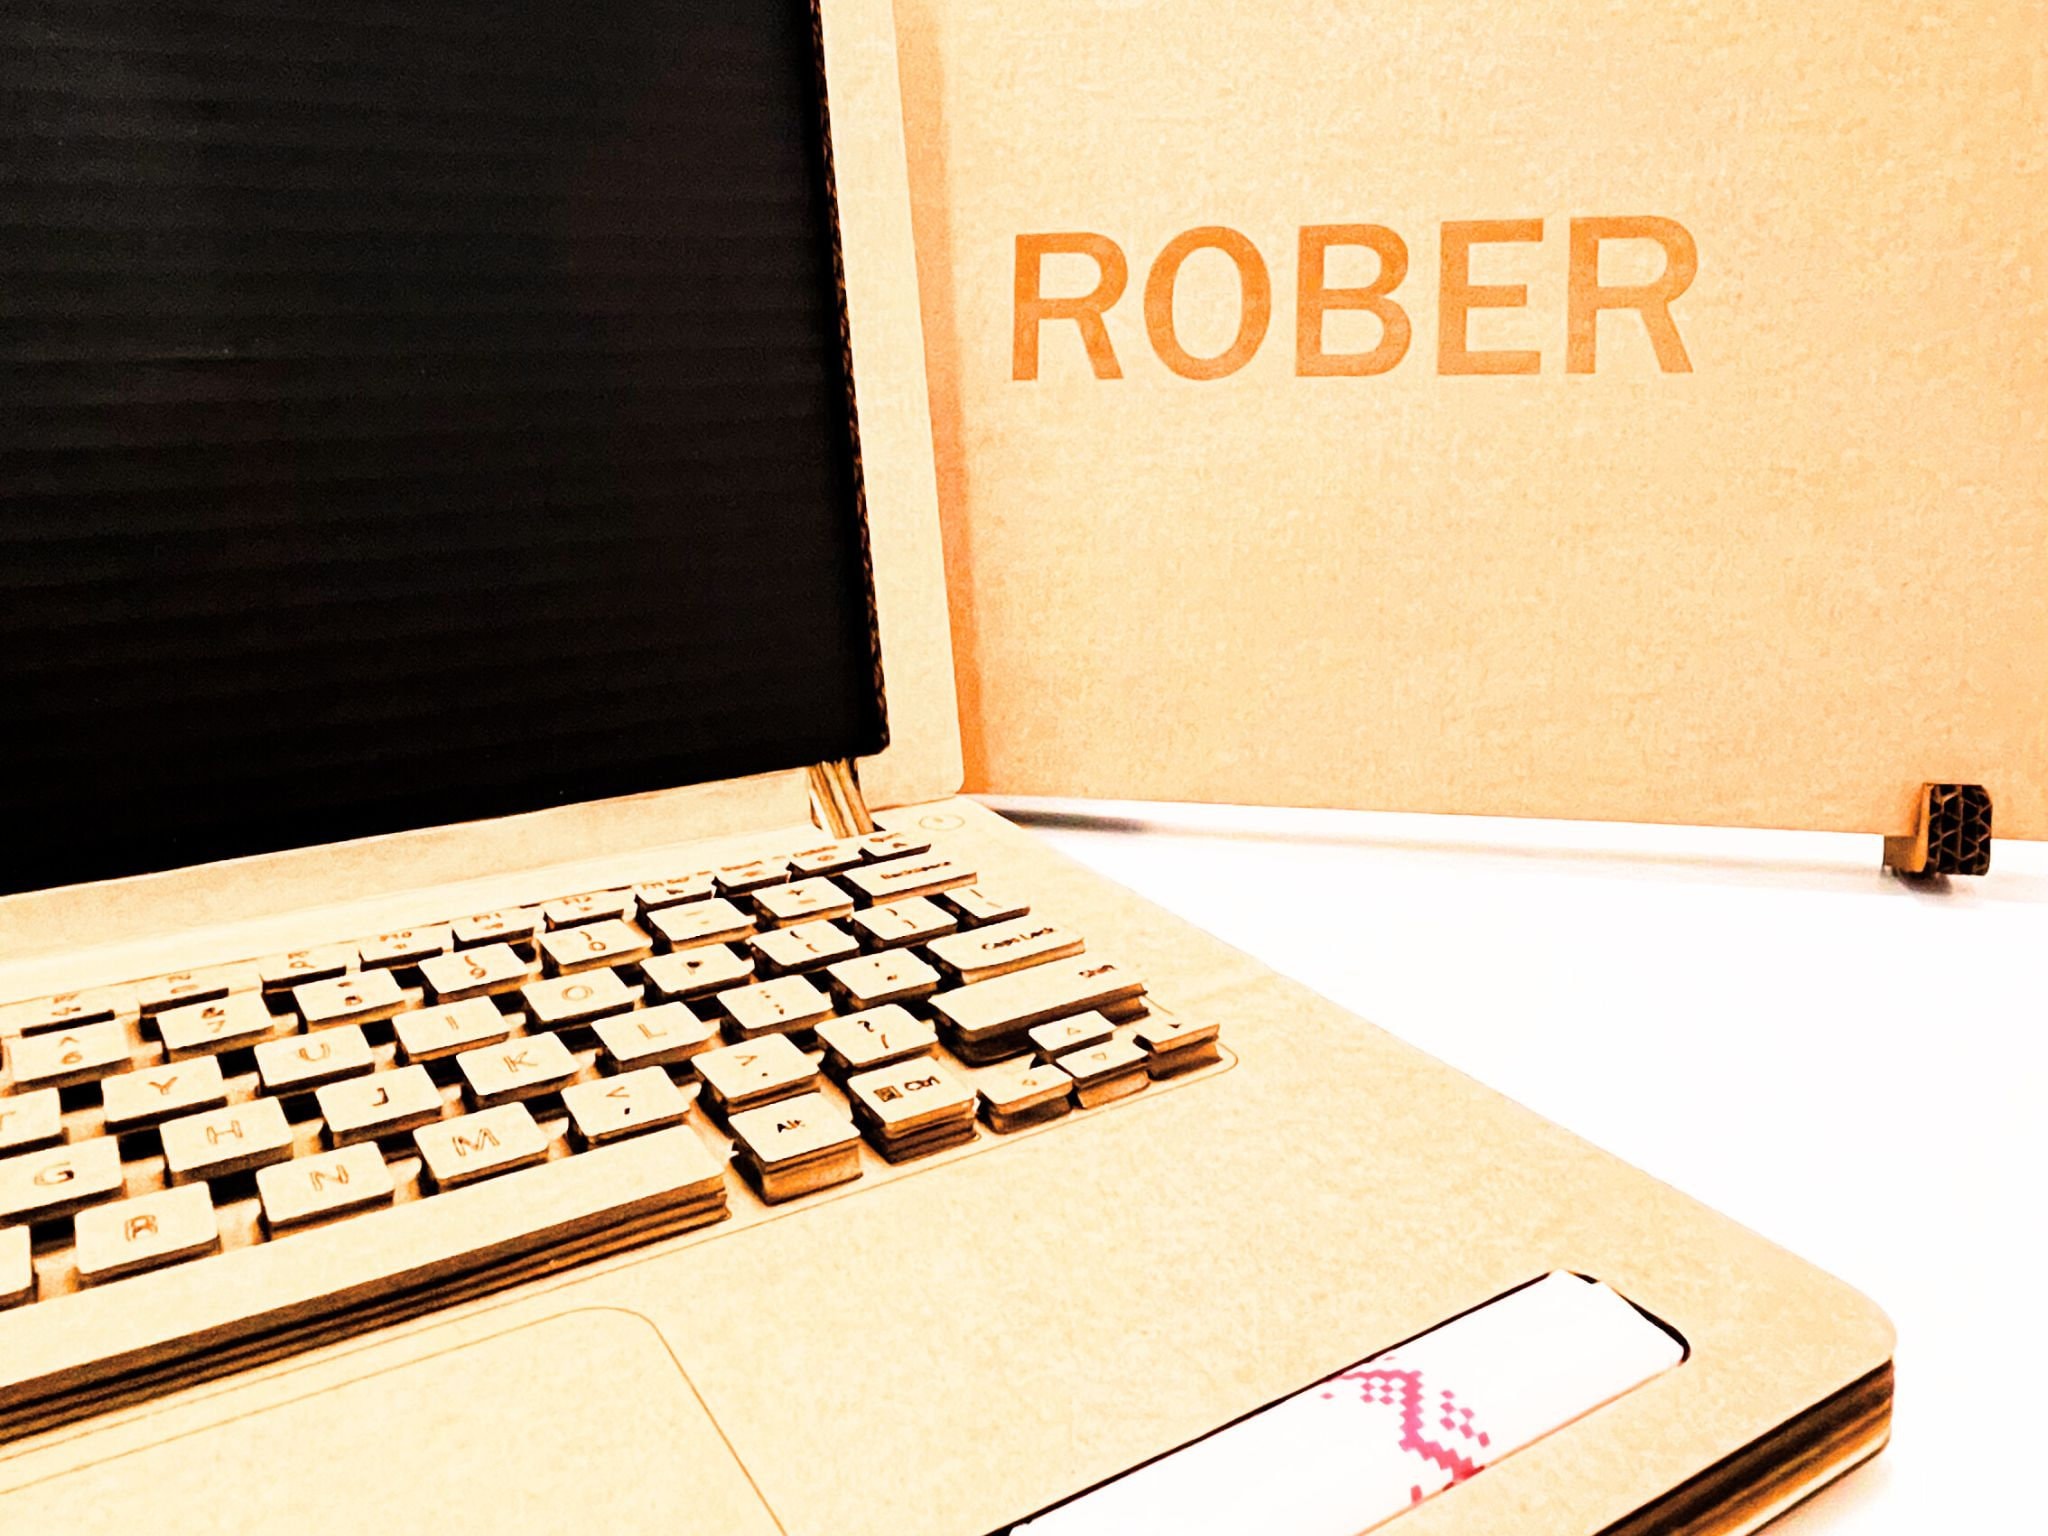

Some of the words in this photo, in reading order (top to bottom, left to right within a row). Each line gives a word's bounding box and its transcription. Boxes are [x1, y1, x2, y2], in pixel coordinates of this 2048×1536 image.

[1012, 215, 1699, 382] ROBER
[637, 1023, 668, 1040] L
[503, 1050, 538, 1073] K
[148, 1076, 178, 1095] Y
[371, 1087, 389, 1106] J
[206, 1120, 244, 1144] H
[452, 1127, 501, 1157] M
[33, 1162, 75, 1186] G
[309, 1163, 349, 1192] N
